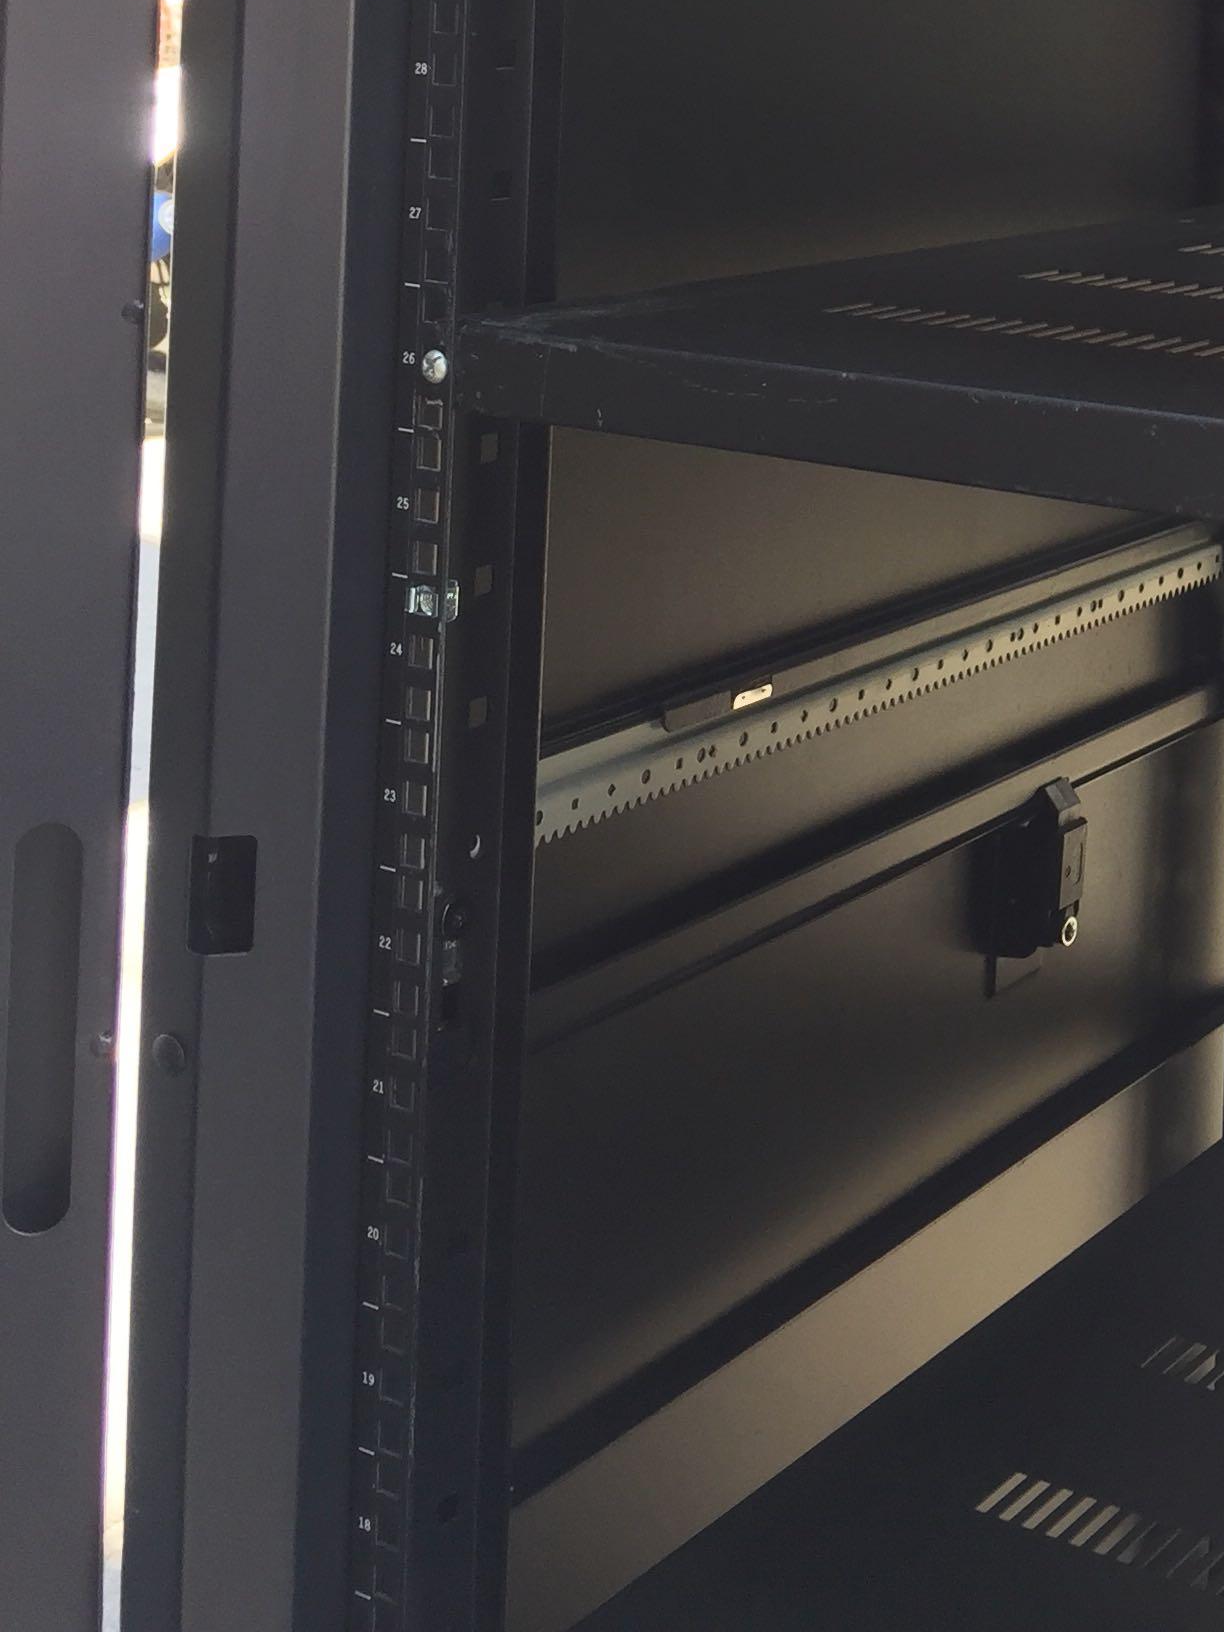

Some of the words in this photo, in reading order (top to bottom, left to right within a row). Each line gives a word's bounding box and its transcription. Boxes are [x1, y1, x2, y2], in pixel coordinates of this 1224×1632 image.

[414, 62, 428, 76] 28
[408, 206, 422, 220] 27
[402, 351, 416, 365] 26
[396, 496, 410, 510] 25
[390, 642, 403, 656] 24
[383, 788, 396, 803] 23
[378, 935, 392, 950] 22
[372, 1079, 385, 1094] 21
[367, 1225, 380, 1241] 20
[361, 1371, 375, 1387] 19
[358, 1516, 371, 1532] 18
